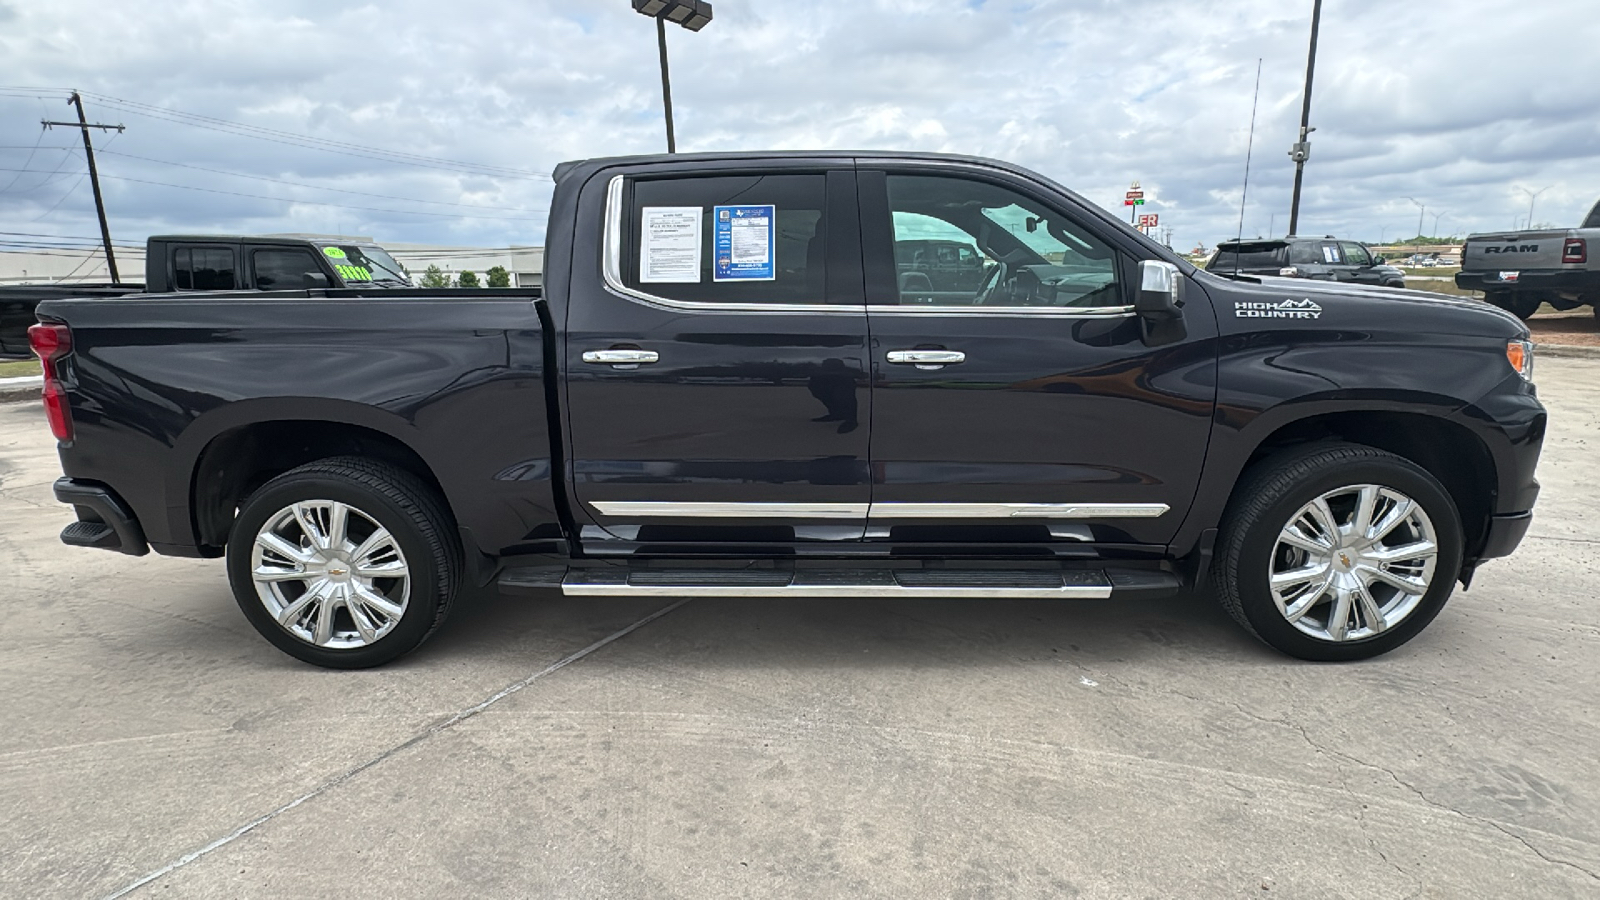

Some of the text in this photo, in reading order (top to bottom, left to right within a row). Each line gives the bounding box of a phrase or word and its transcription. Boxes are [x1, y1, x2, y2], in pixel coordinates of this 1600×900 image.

[1139, 215, 1157, 226] ER
[1484, 244, 1539, 254] RAM
[1234, 302, 1280, 310] HIGH
[1235, 309, 1322, 319] COUNTRY
